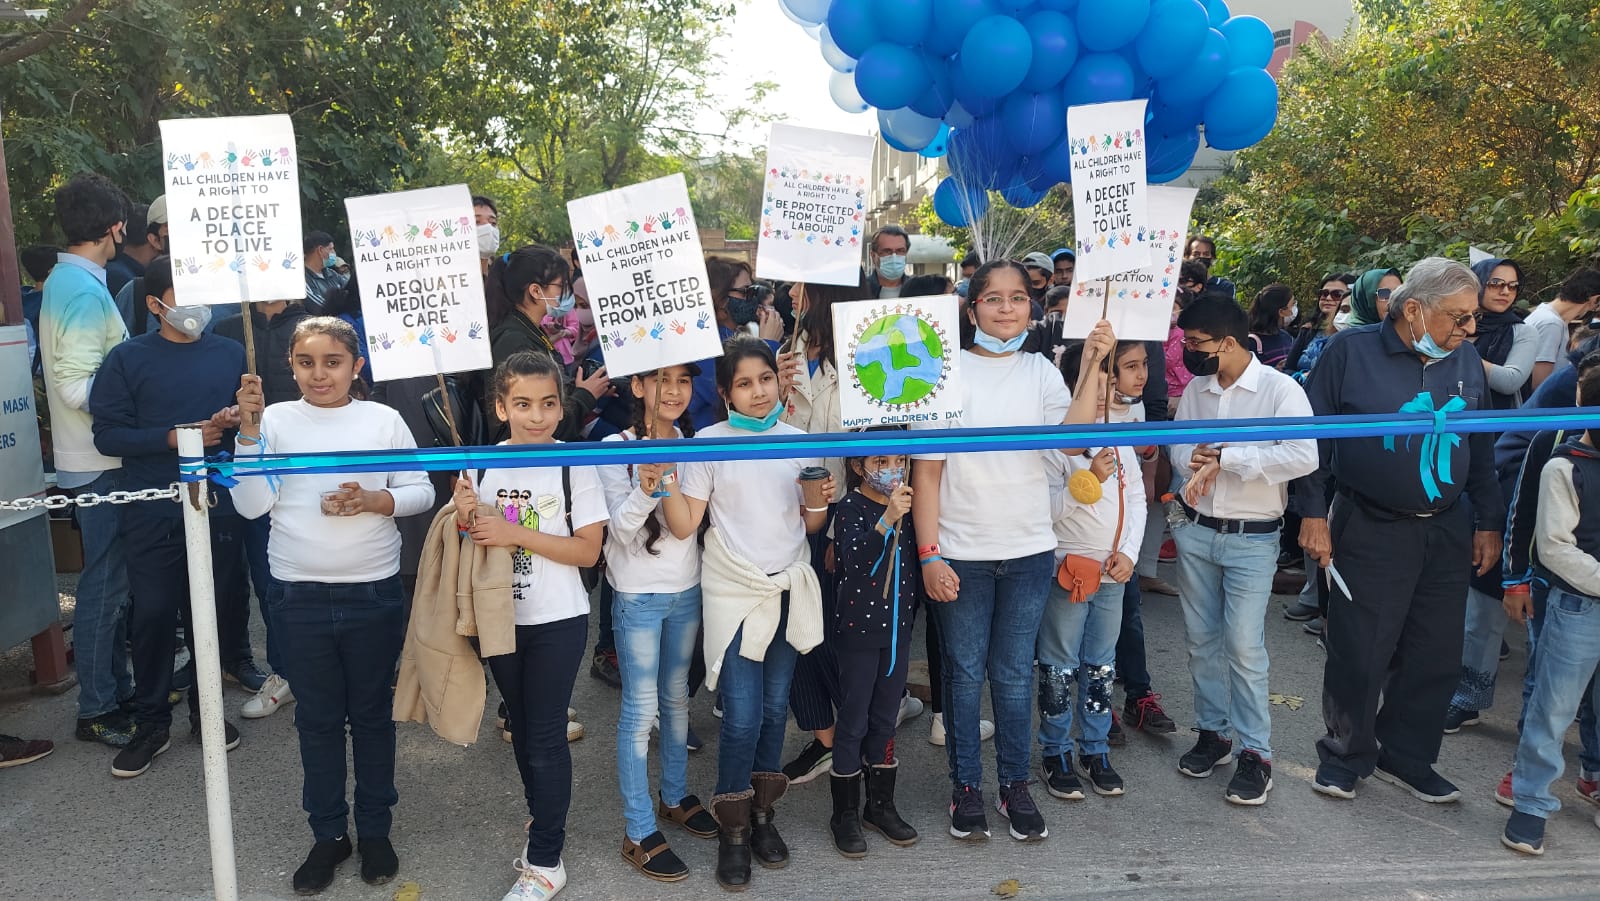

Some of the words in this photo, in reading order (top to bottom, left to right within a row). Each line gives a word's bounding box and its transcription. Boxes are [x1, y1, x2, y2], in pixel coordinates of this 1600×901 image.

[1074, 161, 1086, 170] ALL
[1088, 155, 1122, 167] CHILDREN
[1124, 151, 1141, 160] HAVE
[172, 176, 192, 186] ALL
[197, 173, 254, 184] CHILDREN
[258, 171, 290, 181] HAVE
[1090, 171, 1093, 179] A
[1096, 167, 1117, 178] RIGHT
[1120, 165, 1130, 174] TO
[199, 188, 205, 197] A
[210, 185, 246, 196] RIGHT
[251, 185, 268, 194] TO
[798, 183, 830, 192] CHILDREN
[804, 191, 824, 199] RIGHT
[1086, 190, 1091, 204] A
[1096, 182, 1135, 202] DECENT
[190, 208, 200, 221] A
[208, 203, 279, 220] DECENT
[776, 200, 788, 209] BE
[792, 202, 853, 216] PROTECTED
[1095, 199, 1128, 217] PLACE
[783, 211, 811, 220] FROM
[815, 215, 844, 224] CHILD
[1093, 219, 1107, 233] TO
[1111, 214, 1131, 230] LIVE
[206, 221, 266, 237] PLACE
[792, 222, 833, 233] LABOUR
[202, 240, 228, 254] TO
[235, 237, 272, 252] LIVE
[361, 252, 380, 262] ALL
[383, 244, 437, 259] CHILDREN
[441, 240, 470, 252] HAVE
[585, 252, 604, 264] ALL
[607, 238, 659, 258] CHILDREN
[662, 231, 690, 245] HAVE
[386, 263, 392, 272] A
[396, 258, 430, 271] RIGHT
[435, 256, 451, 266] TO
[611, 262, 617, 271] A
[620, 253, 653, 268] RIGHT
[657, 249, 673, 259] TO
[376, 273, 469, 298] ADEQUATE
[633, 270, 654, 286] BE
[1095, 273, 1154, 283] UCATION
[387, 292, 460, 313] MEDICAL
[598, 277, 699, 311] PROTECTED
[403, 310, 448, 327] CARE
[600, 306, 646, 328] FROM
[653, 292, 706, 316] ABUSE
[3, 396, 30, 415] MASK
[843, 418, 872, 426] HAPPY
[881, 413, 938, 424] CHILDREN'S
[946, 410, 963, 419] DAY
